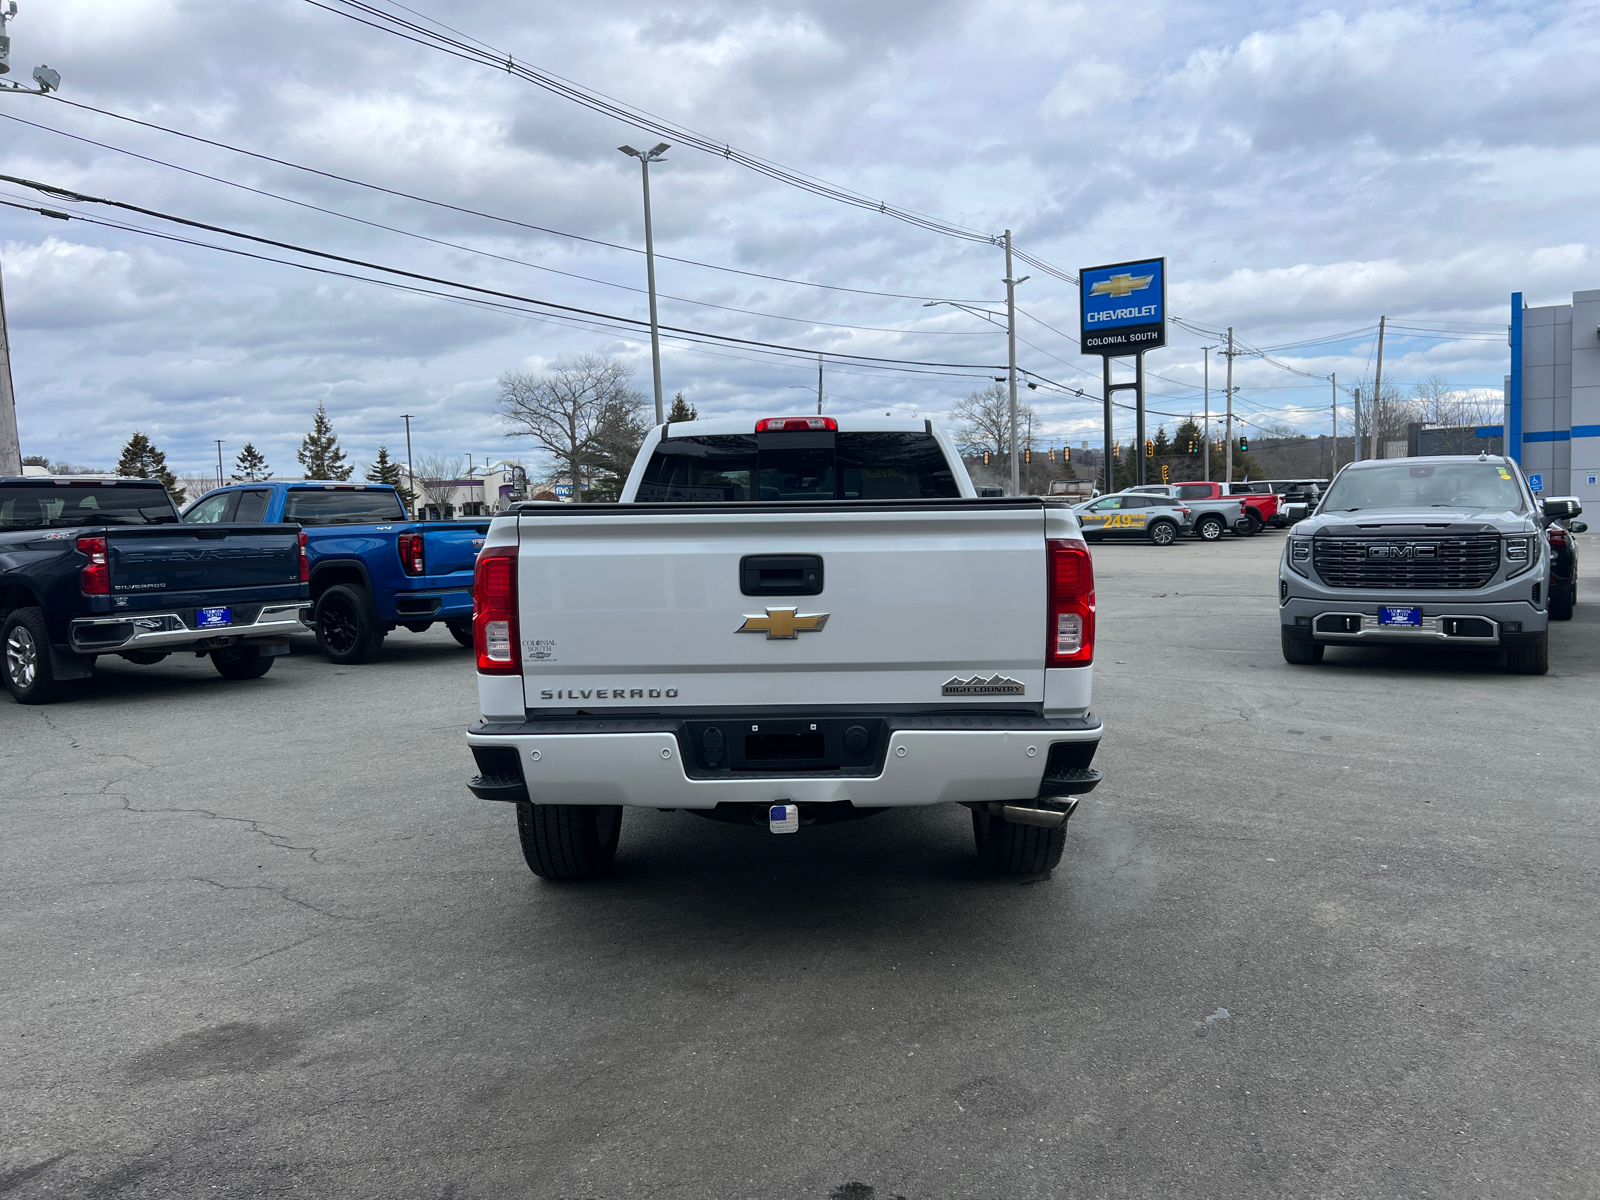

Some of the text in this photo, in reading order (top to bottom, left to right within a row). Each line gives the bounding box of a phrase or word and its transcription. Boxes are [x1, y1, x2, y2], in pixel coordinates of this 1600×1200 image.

[1087, 304, 1157, 323] CHEVROLET
[1087, 331, 1158, 347] COLONIAL SOUTH
[125, 547, 290, 563] CHEVROLET
[1369, 546, 1435, 558] GMC
[540, 688, 679, 700] SILVERADO
